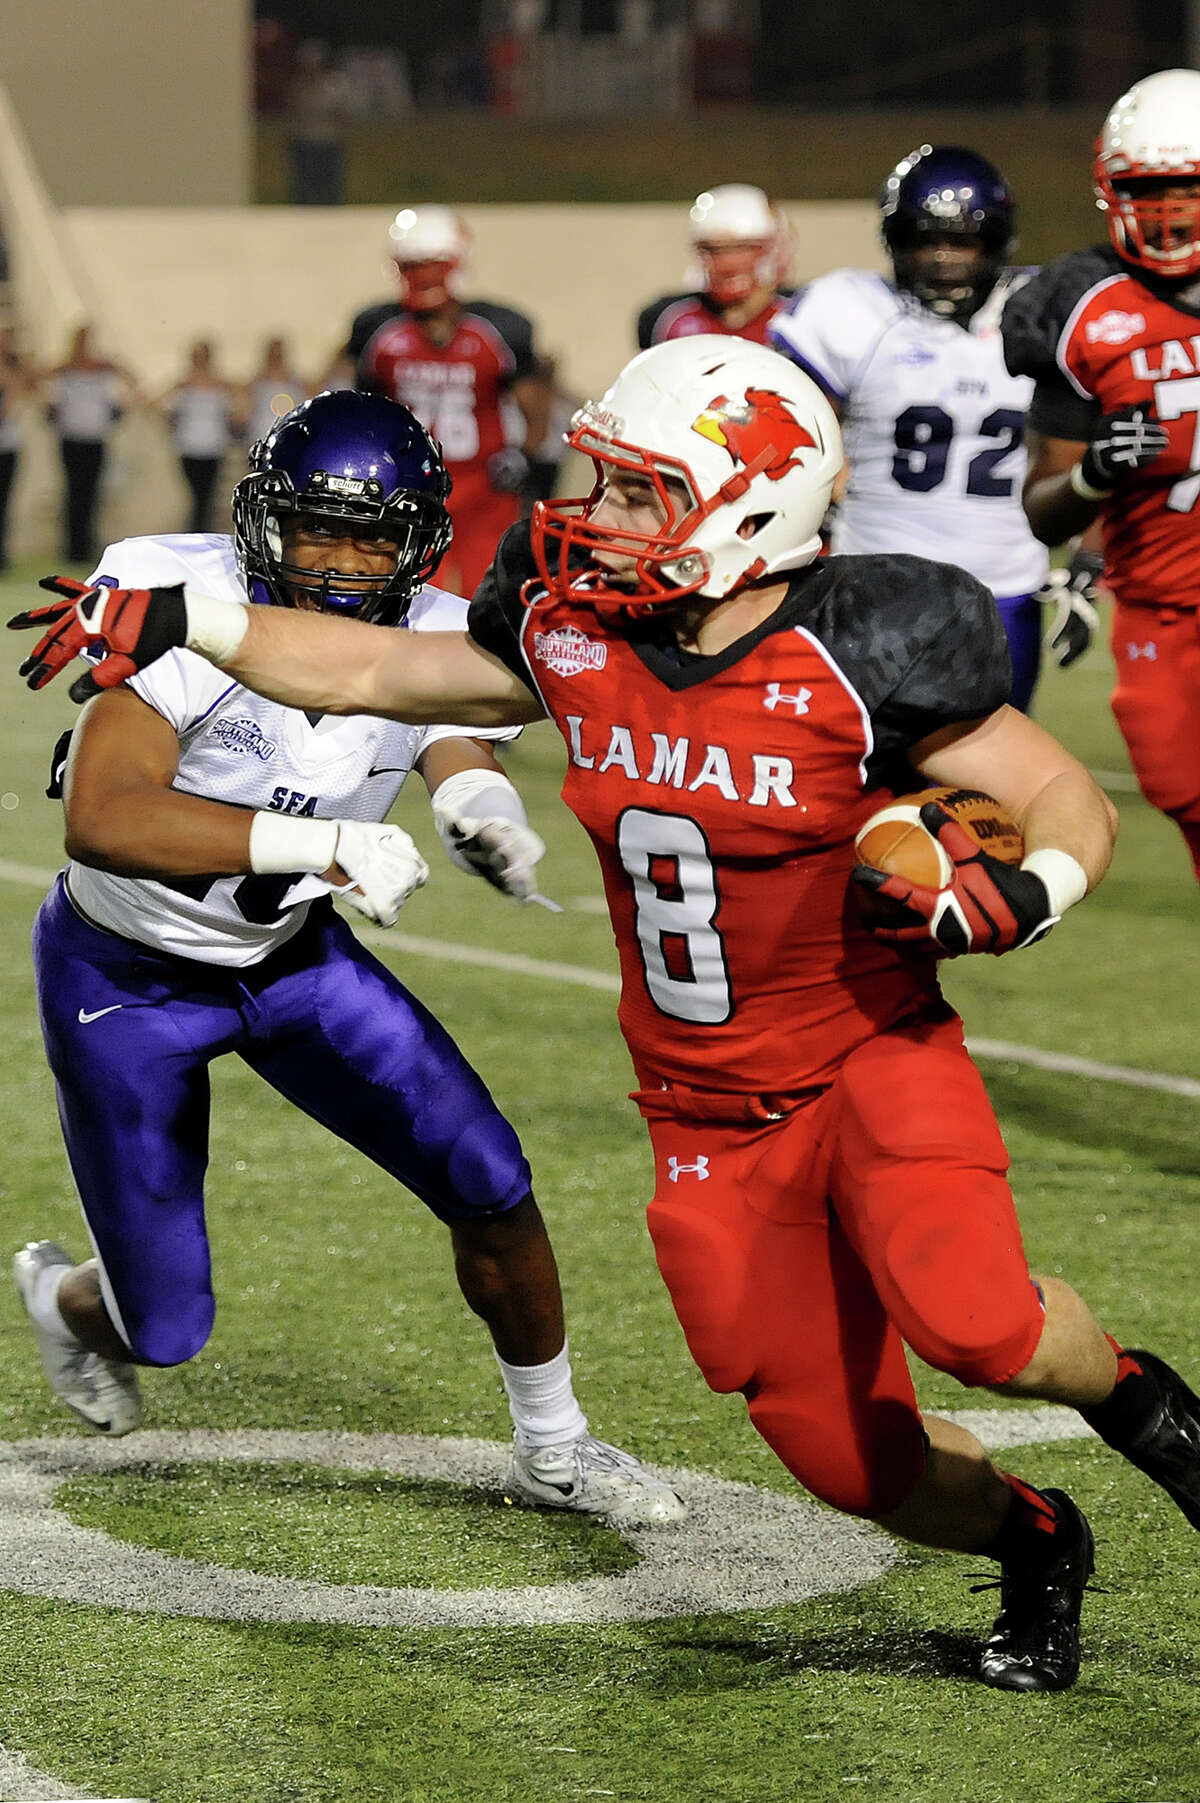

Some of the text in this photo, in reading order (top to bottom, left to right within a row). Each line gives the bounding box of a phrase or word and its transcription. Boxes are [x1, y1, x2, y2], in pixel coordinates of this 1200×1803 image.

[891, 405, 1026, 497] 92
[535, 632, 607, 669] SOUTHLAND
[267, 786, 319, 818] SFA
[566, 715, 798, 807] LAMAR
[615, 805, 736, 1026] 8
